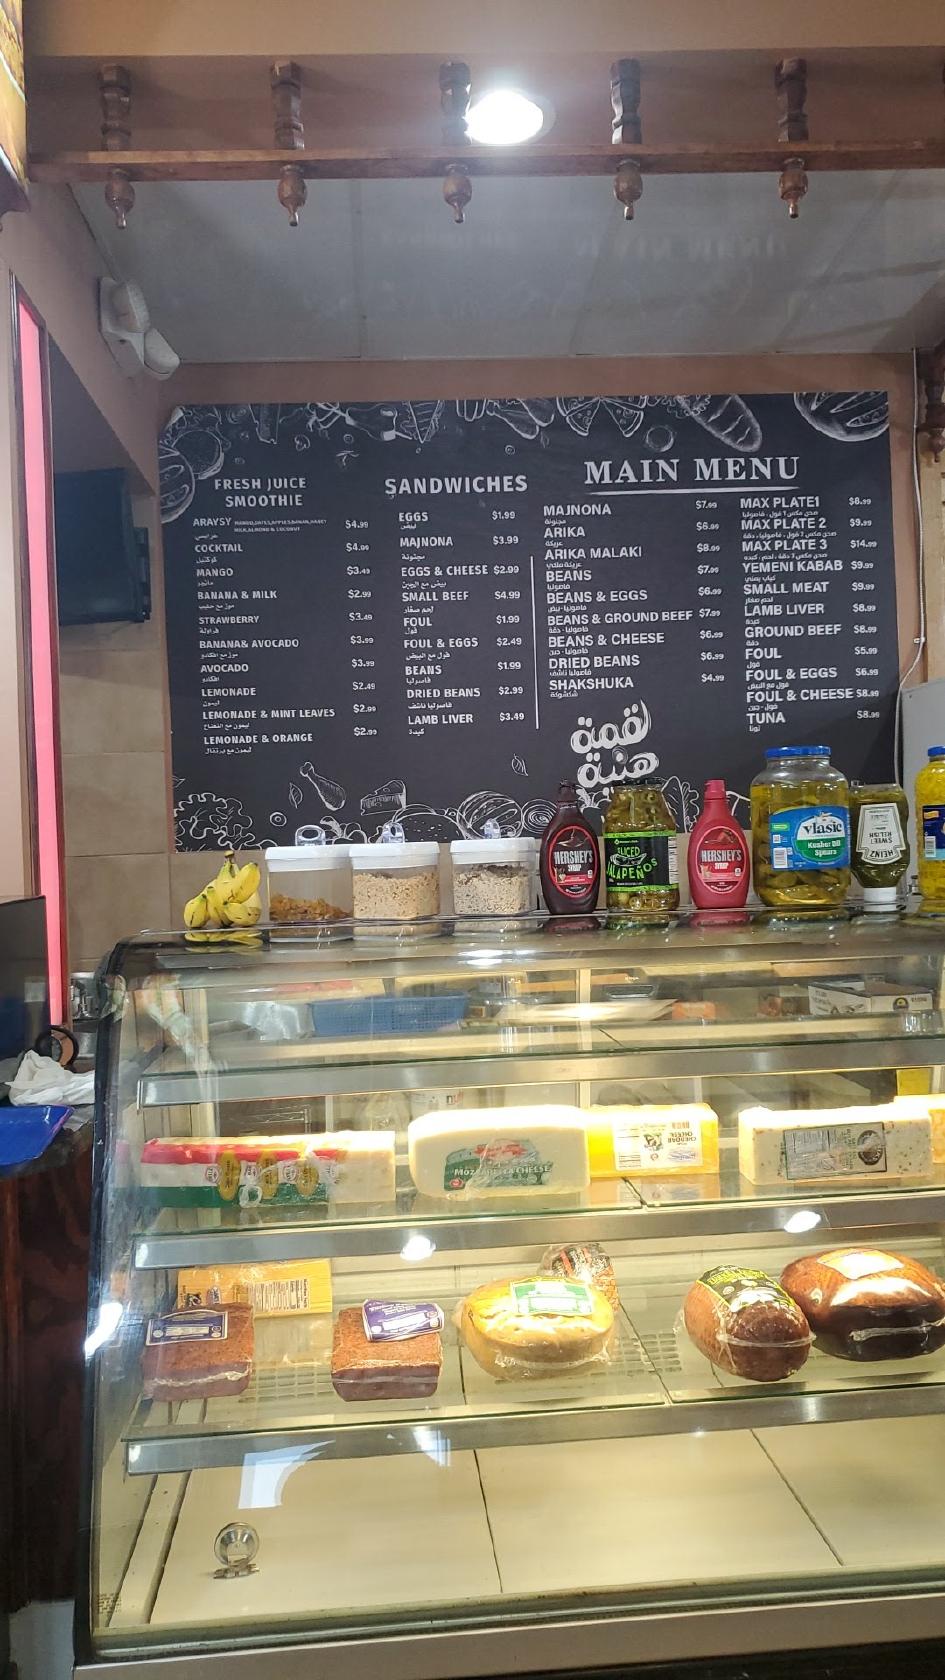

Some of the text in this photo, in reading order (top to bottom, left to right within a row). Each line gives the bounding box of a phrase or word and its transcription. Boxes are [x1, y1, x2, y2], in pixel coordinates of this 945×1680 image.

[584, 457, 799, 484] MAIN MENU
[215, 478, 305, 491] FRESH JUICE
[385, 475, 527, 494] SANDWICHES
[226, 495, 302, 507] SMOOTHIE
[741, 498, 769, 508] MAX
[399, 511, 515, 521] EGGS $1.99
[544, 504, 611, 516] MAJNONA
[193, 518, 231, 526] ARAYSY
[742, 519, 770, 530] MAX
[774, 518, 815, 529] PLATE
[819, 518, 826, 528] 2
[544, 527, 585, 538] ARIKA
[195, 544, 243, 552] COCKTAIL
[400, 536, 518, 548] MAJNONA $3.99
[742, 541, 771, 551] MAX
[775, 539, 816, 550] PLATE
[820, 539, 827, 549] 3
[545, 549, 586, 560] ARIKA
[591, 547, 641, 558] MALAKI
[197, 568, 233, 576] MANGO
[402, 565, 519, 576] EGGS & CHEESE $2.99
[743, 562, 793, 573] YEMENI
[797, 560, 843, 571] KABAB
[546, 570, 591, 582] BEANS
[744, 584, 788, 595] SMALL
[793, 582, 829, 592] MEAT
[242, 591, 248, 599] &
[402, 591, 520, 601] SMALL BEEF $4.99
[547, 592, 592, 604] BEANS
[596, 592, 606, 601] &
[611, 590, 647, 601] EGGS
[745, 605, 782, 616] LAMB
[787, 604, 824, 614] LIVER
[199, 616, 259, 624] STRAWBERRY
[404, 615, 519, 626] FOUL $1.99
[548, 614, 588, 625] BEANS
[592, 614, 600, 624] &
[605, 612, 658, 623] GROUND
[662, 611, 692, 621] BEEF
[745, 626, 804, 638] GROUND
[808, 624, 841, 635] BEEF
[252, 639, 298, 647] AVOCADO
[404, 637, 521, 648] FOUL & EGGS $2.49
[549, 635, 593, 647] BEANS
[598, 635, 607, 645] &
[612, 633, 664, 645] CHEESE
[746, 648, 781, 659] FOUL
[201, 664, 248, 672] AVOCADO
[549, 657, 590, 669] DRIED
[594, 655, 640, 667] BEANS
[405, 662, 521, 675] BEANS $1.99
[746, 669, 782, 681] FOUL
[786, 669, 795, 679] &
[800, 668, 837, 678] EGGS
[550, 677, 633, 690] SHAKSHUKA
[202, 688, 256, 696] LEMONADE
[407, 687, 523, 698] DRIED BEANS $2.99
[747, 691, 783, 702] FOUL
[787, 690, 796, 701] &
[801, 688, 853, 700] CHEESE
[203, 711, 256, 719] LEMONADE
[271, 710, 296, 718] MINT
[300, 709, 335, 717] LEAVES
[408, 712, 524, 724] LAMB LIVER $3.49
[746, 712, 785, 724] TUNA
[571, 699, 652, 754] لقمة
[204, 735, 258, 744] LEMONADE
[273, 734, 312, 742] ORANGE
[804, 819, 842, 834] vlasic
[554, 850, 593, 865] HERSHEY'S
[617, 847, 640, 856] SLICED
[702, 849, 742, 862] HERSHEY'S
[870, 849, 894, 858] HEINZ
[607, 858, 658, 880] JALAPEÑOS
